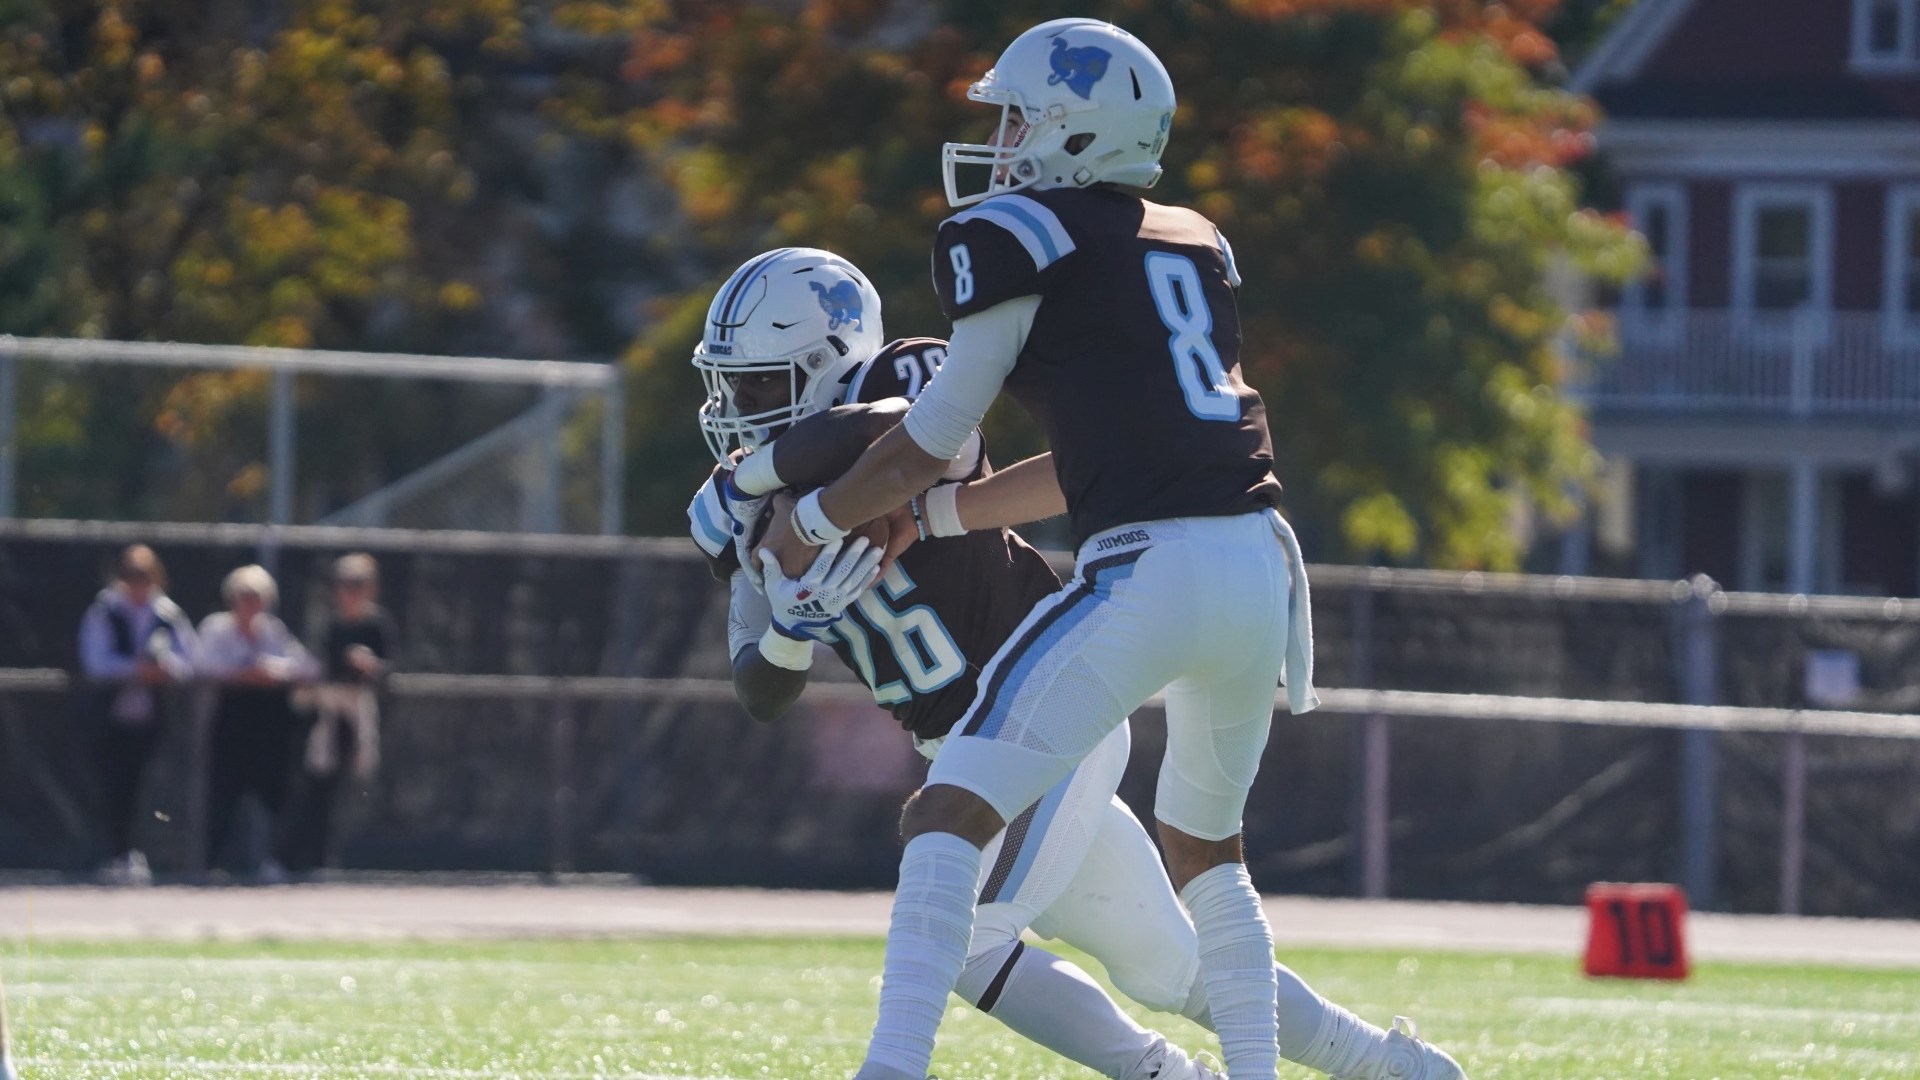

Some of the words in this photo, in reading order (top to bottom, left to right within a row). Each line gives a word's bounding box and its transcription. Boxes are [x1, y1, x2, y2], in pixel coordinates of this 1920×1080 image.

[950, 243, 975, 306] 8
[1144, 251, 1240, 422] 8
[1096, 529, 1150, 552] JUMBOS
[787, 608, 831, 619] adidas
[1607, 901, 1676, 967] 10
